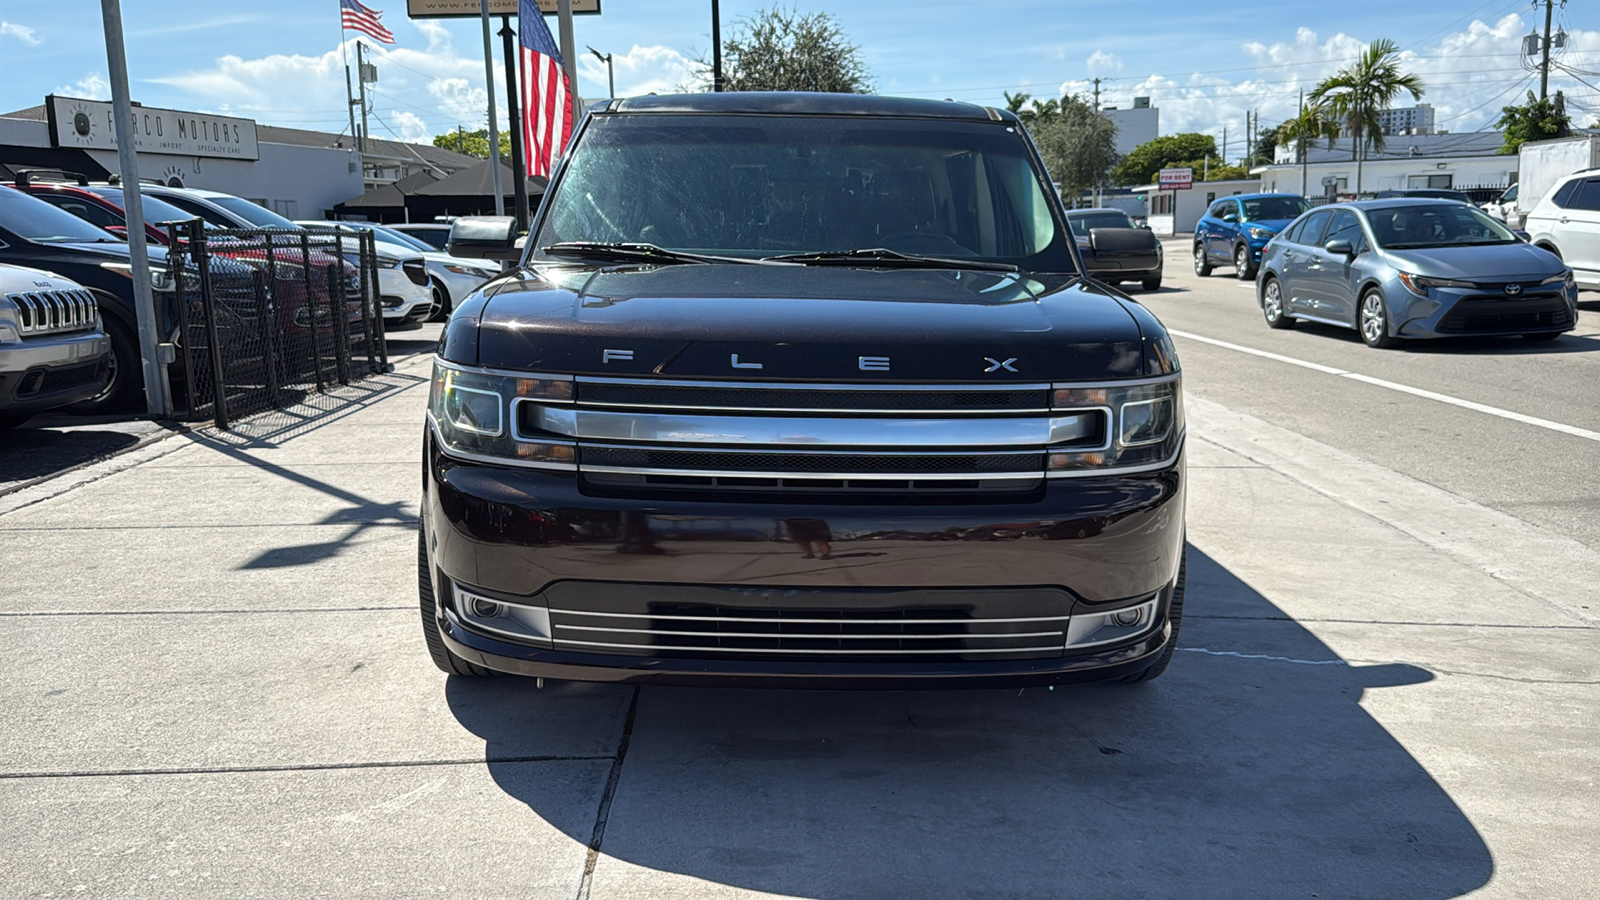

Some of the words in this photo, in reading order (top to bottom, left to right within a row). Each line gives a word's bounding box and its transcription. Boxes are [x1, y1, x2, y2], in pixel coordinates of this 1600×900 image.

[107, 110, 163, 137] FRCO
[178, 118, 240, 144] MOTORS
[197, 144, 226, 153] SPECIALTY
[602, 348, 1019, 374] FLEX
